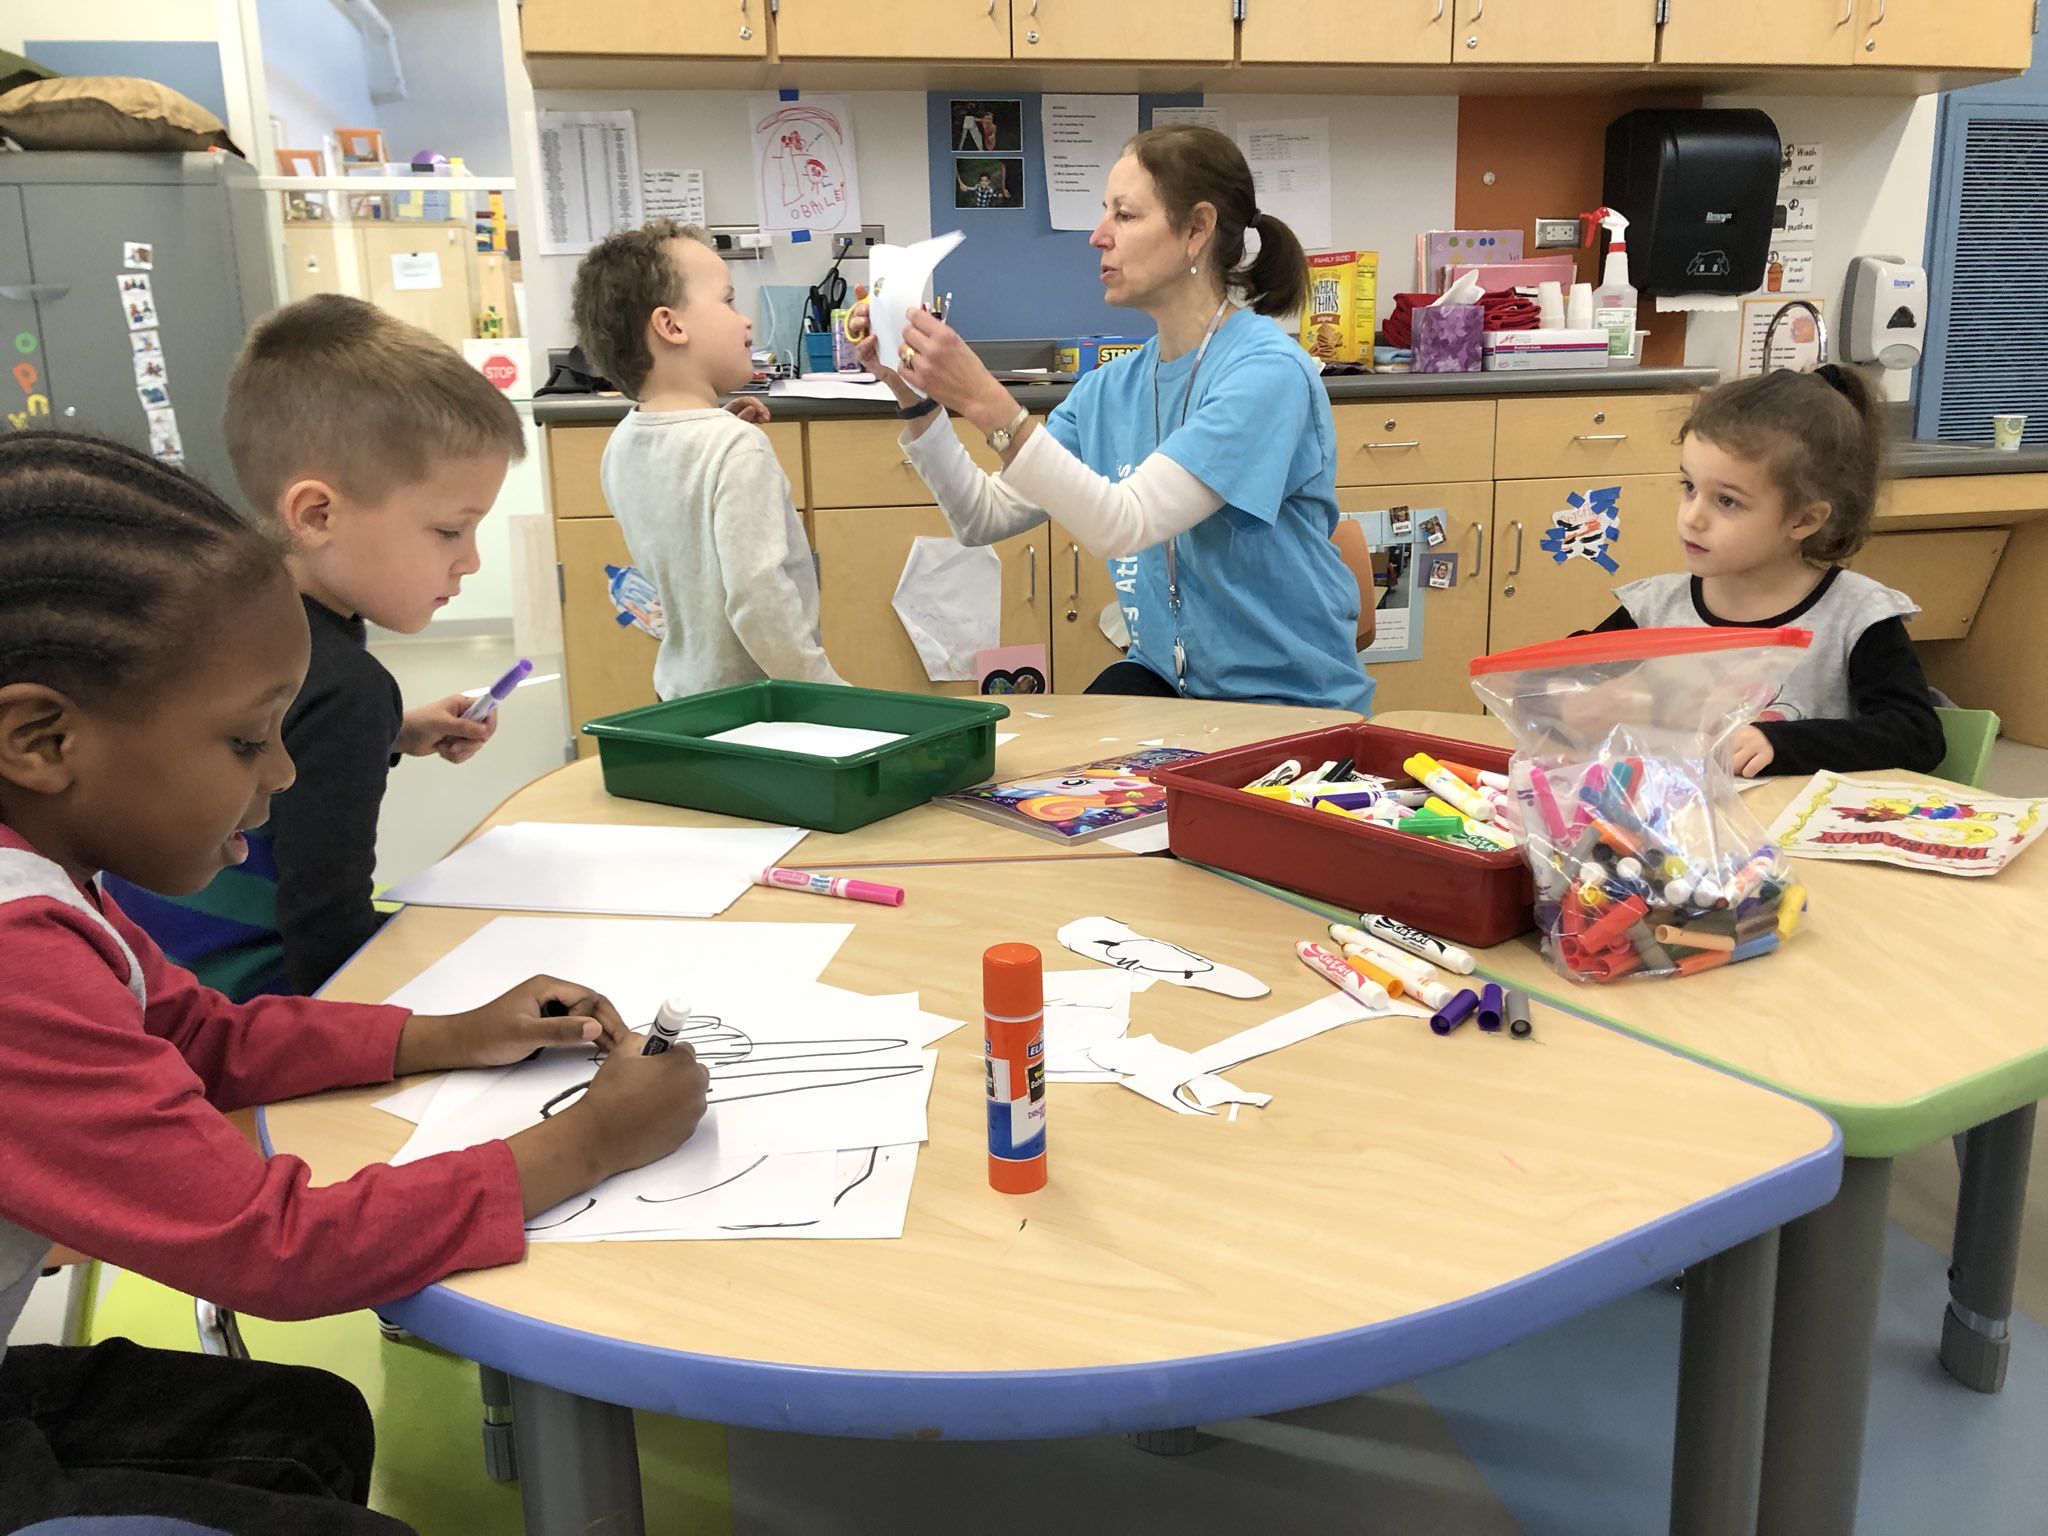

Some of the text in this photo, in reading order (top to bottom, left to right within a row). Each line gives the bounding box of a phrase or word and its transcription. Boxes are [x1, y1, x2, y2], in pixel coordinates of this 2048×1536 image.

[1797, 147, 1817, 157] Wash
[1788, 222, 1814, 232] pushes
[1314, 256, 1335, 264] FAMILY
[1313, 280, 1340, 295] WHEAT
[1313, 294, 1339, 314] THINS
[485, 366, 515, 379] STOP
